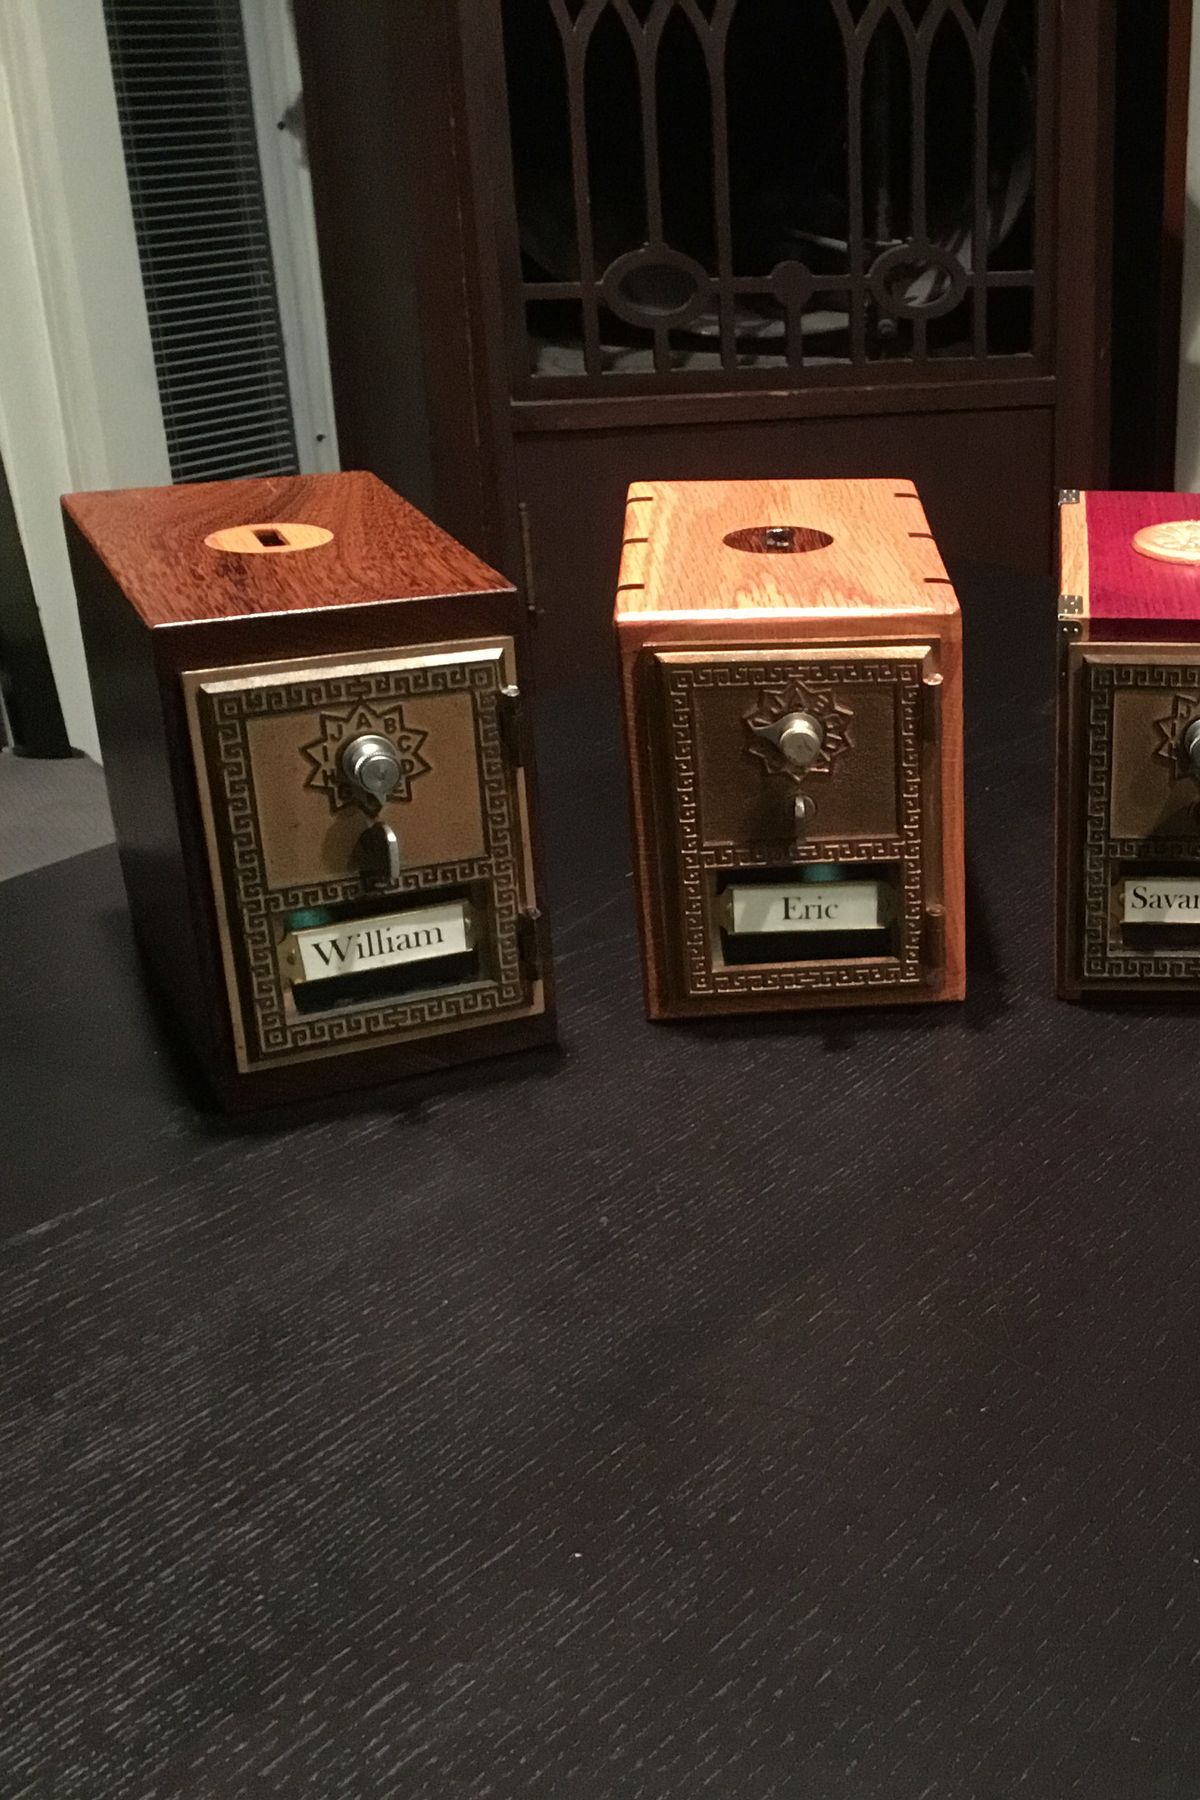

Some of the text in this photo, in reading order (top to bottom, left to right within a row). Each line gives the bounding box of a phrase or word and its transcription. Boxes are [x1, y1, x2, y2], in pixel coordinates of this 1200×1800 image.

[356, 712, 372, 730] A
[384, 717, 397, 734] B
[330, 723, 343, 741] J
[398, 735, 411, 753] C
[401, 758, 414, 774] D
[782, 896, 840, 921] Eric
[312, 926, 444, 966] William
